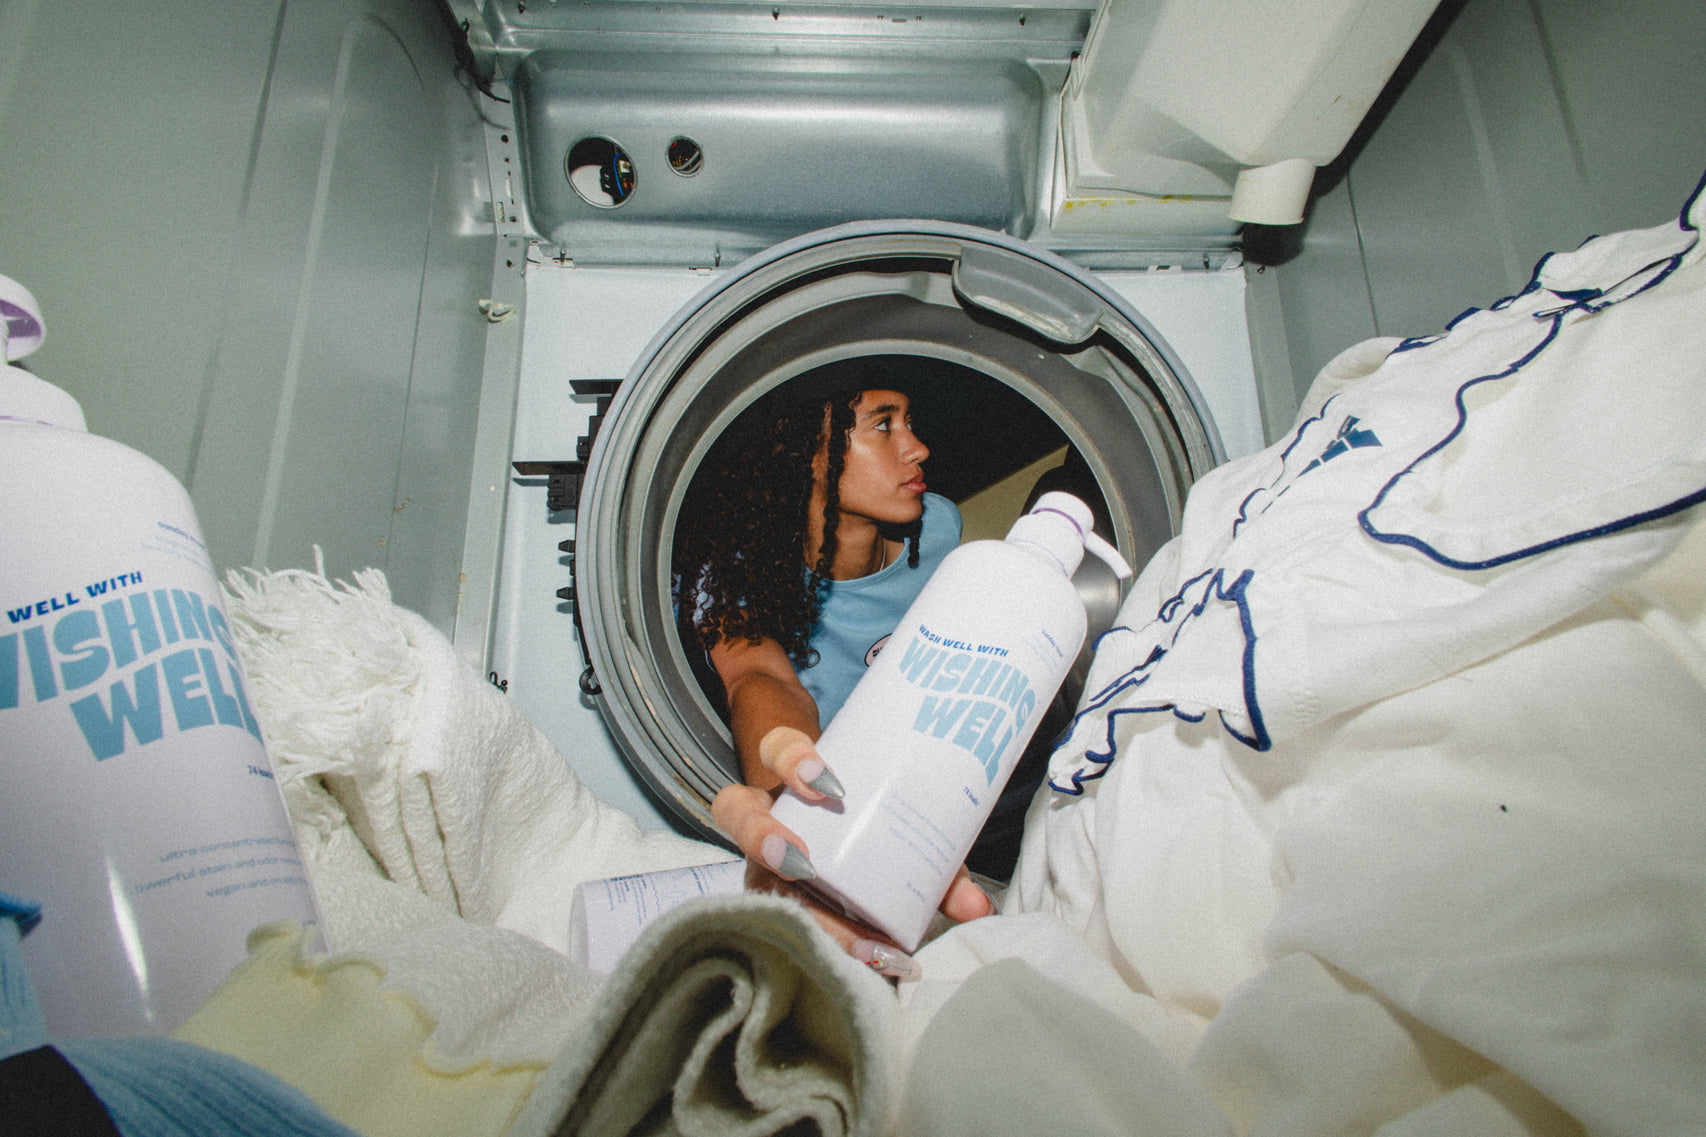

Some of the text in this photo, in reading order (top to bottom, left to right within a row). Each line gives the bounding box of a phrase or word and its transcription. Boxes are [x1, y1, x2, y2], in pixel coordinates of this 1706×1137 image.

[7, 571, 143, 624] WELL WITH
[919, 623, 1009, 657] WASH WELL WITH
[68, 647, 265, 762] WELL
[899, 635, 1036, 738] WISHING
[912, 695, 1014, 788] WELL
